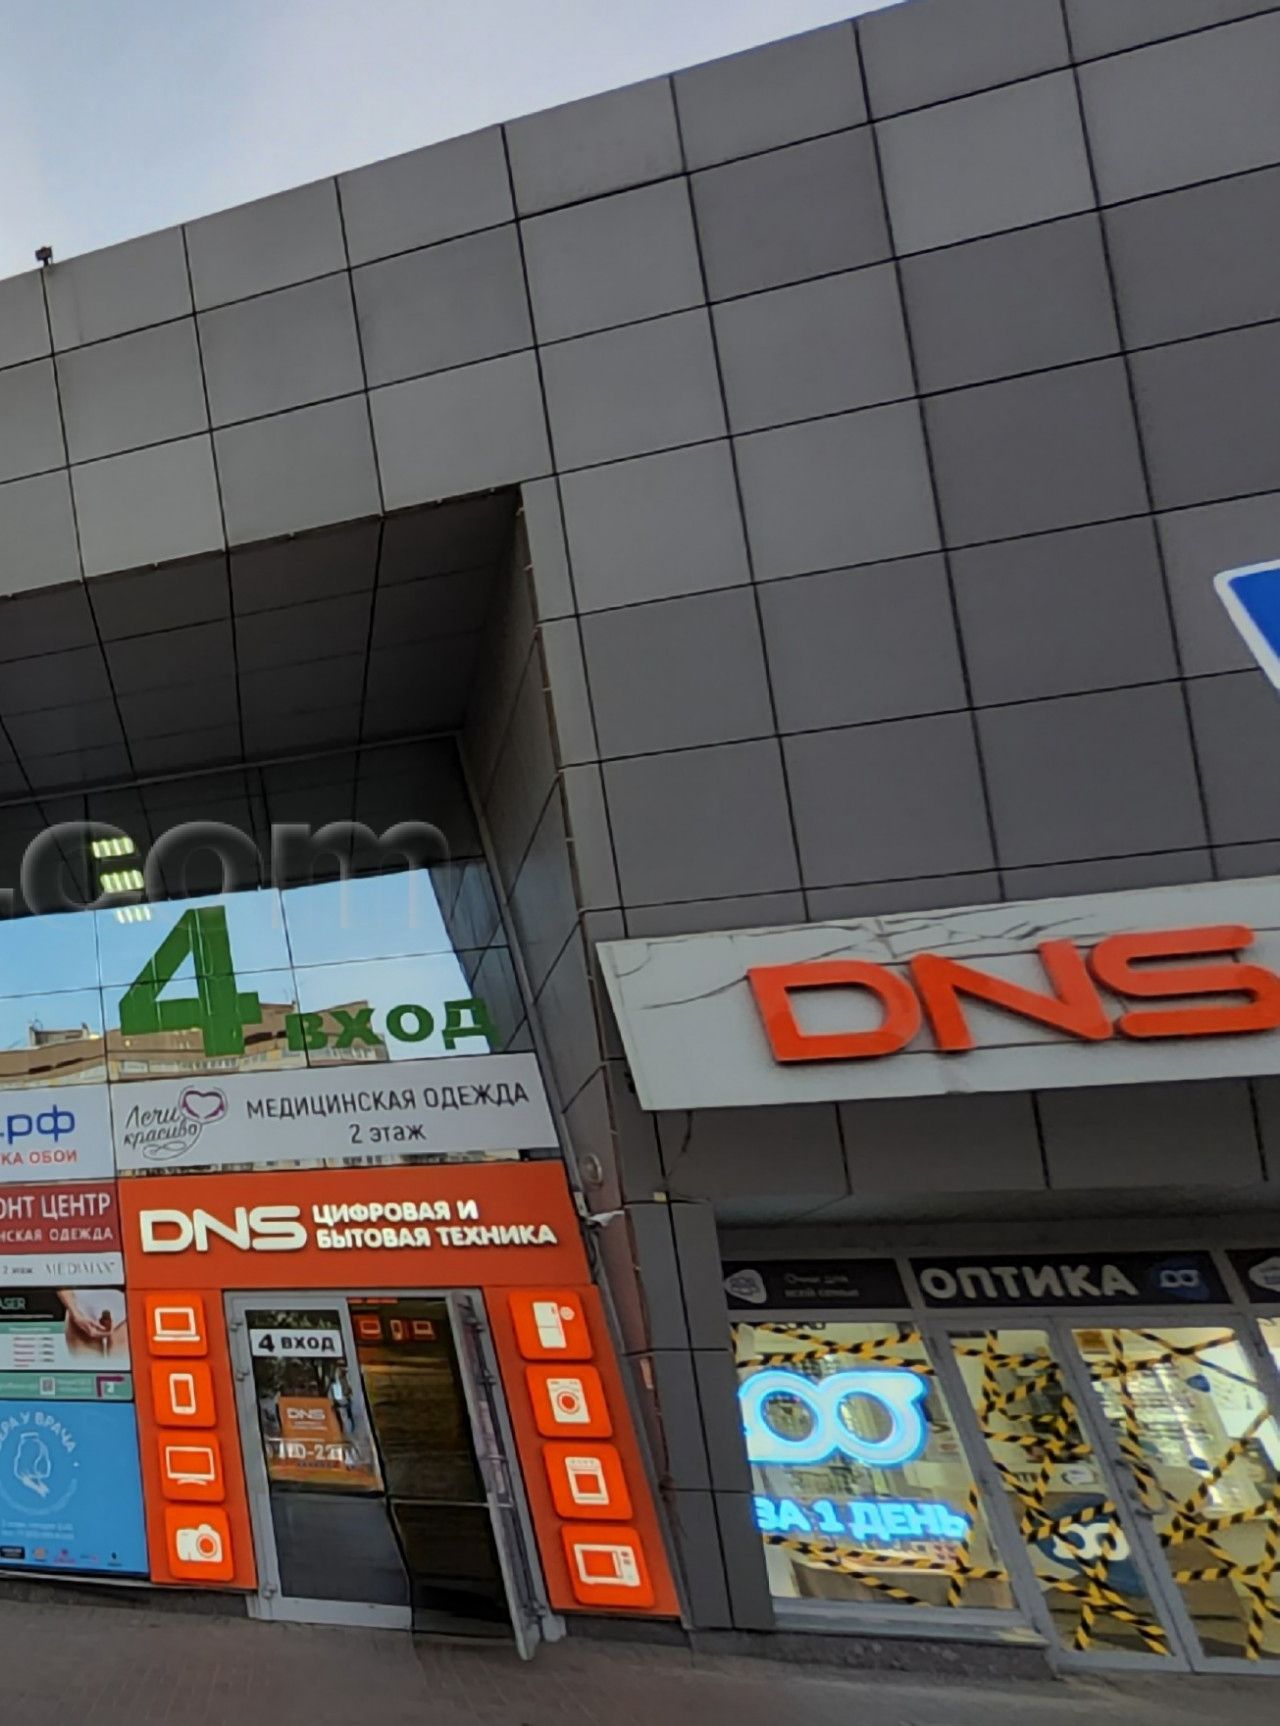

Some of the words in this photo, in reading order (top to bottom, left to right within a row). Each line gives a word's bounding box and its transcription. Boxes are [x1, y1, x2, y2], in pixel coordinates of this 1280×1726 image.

[119, 905, 261, 1056] 4
[747, 924, 1280, 1062] DNS
[246, 1087, 417, 1121] МЕДИЦИНСКАЯ
[424, 1082, 531, 1111] ОДЕЖДА
[349, 1125, 362, 1144] 2
[370, 1123, 427, 1144] этаж
[29, 1149, 78, 1164] ОБОИ
[41, 1193, 111, 1219] ЦЕНТР
[312, 1201, 452, 1225] ЦИФРОВАЯ
[457, 1200, 480, 1219] И
[50, 1227, 113, 1241] ОДЕЖДА
[139, 1205, 308, 1253] DNS
[316, 1228, 432, 1249] БЫТОВАЯ
[435, 1224, 558, 1246] ТЕХНИКА
[923, 1265, 1138, 1298] ОПТИКА
[259, 1334, 274, 1352] 4
[754, 1497, 812, 1532] ЗА
[812, 1500, 846, 1533] 1
[847, 1503, 970, 1541] ДЕНЬ
